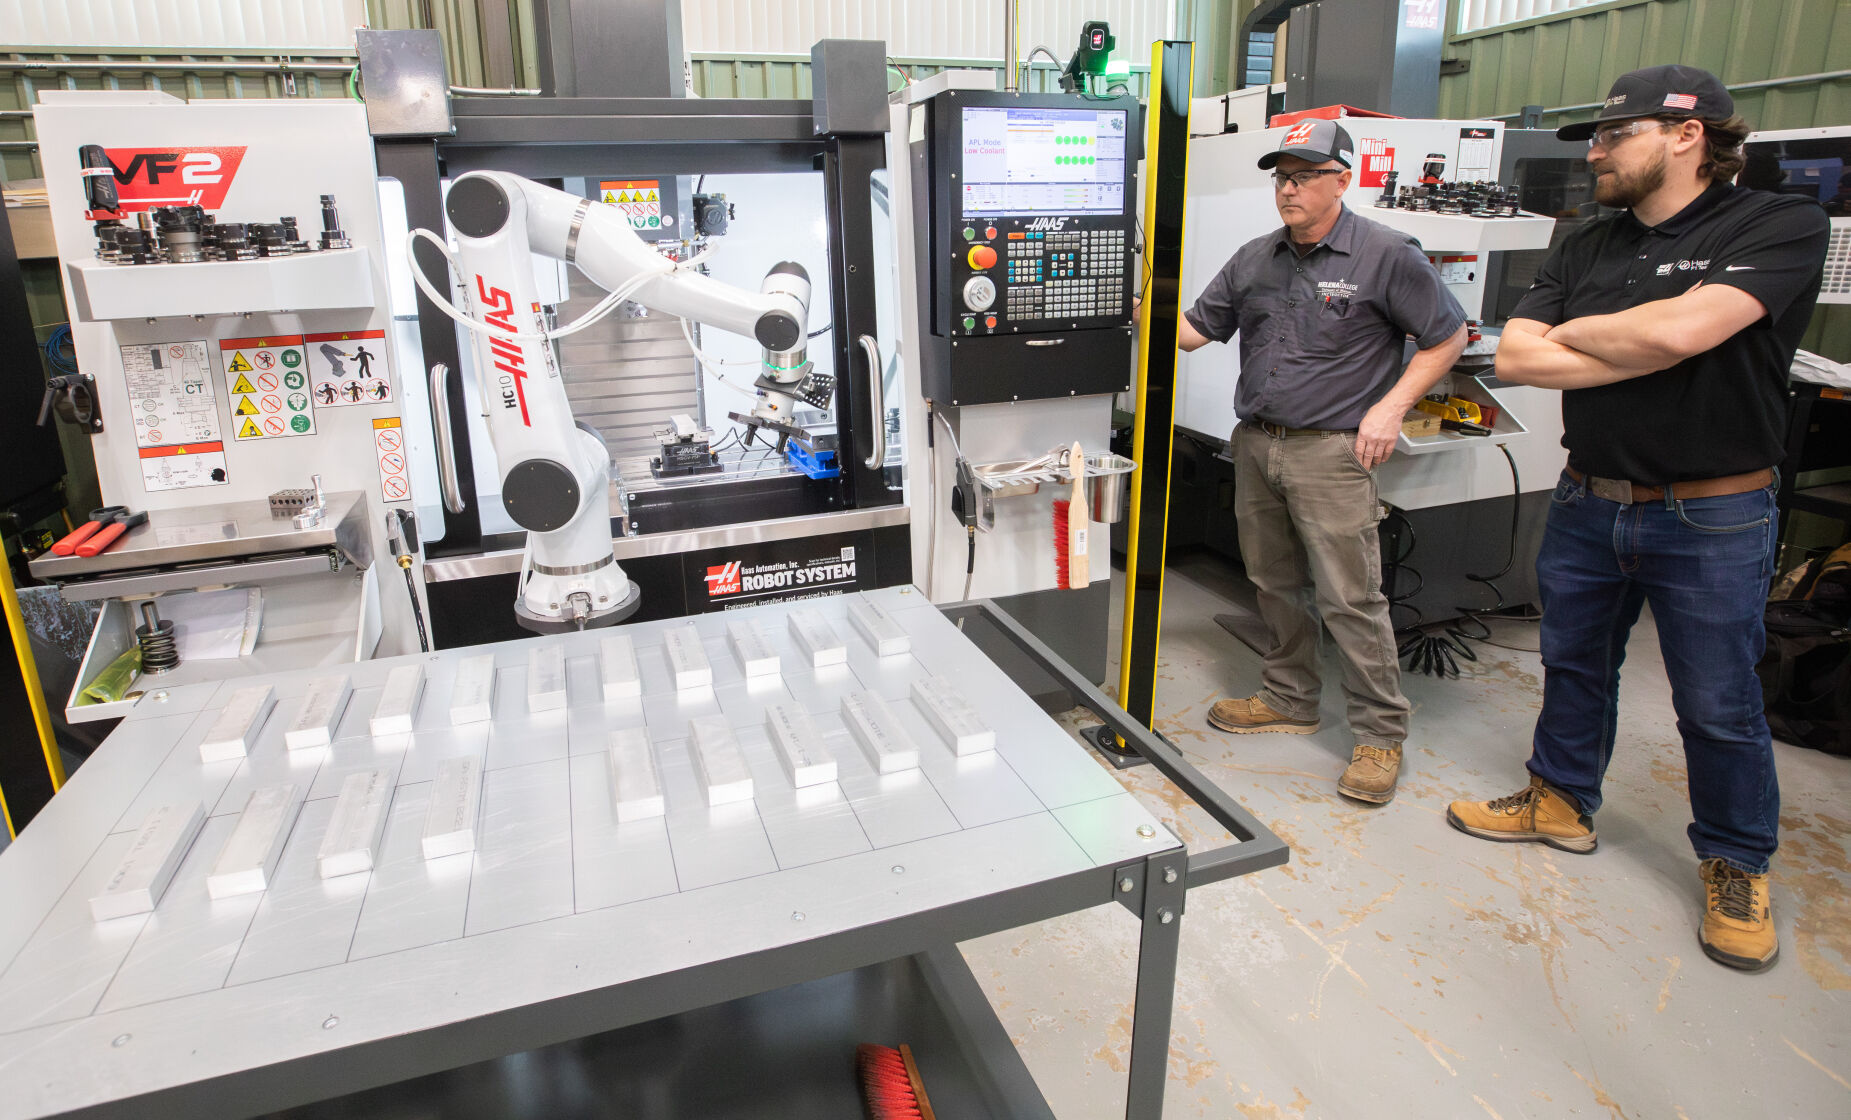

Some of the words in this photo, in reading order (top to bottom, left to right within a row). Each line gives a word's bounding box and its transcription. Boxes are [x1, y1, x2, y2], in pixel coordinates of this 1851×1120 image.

[968, 138, 982, 146] APL
[983, 138, 1001, 146] Mode
[1360, 138, 1387, 156] Mini
[964, 147, 978, 155] Low
[979, 147, 1005, 155] Coolant
[1369, 156, 1393, 172] Mill
[1025, 217, 1069, 231] HAAS
[185, 383, 203, 394] CT
[499, 375, 517, 409] HC10
[741, 567, 754, 575] Haas
[789, 561, 800, 569] Inc.
[742, 570, 794, 592] ROBOT
[795, 562, 856, 584] SYSTEM
[709, 583, 740, 594] HAAS
[797, 591, 820, 601] serviced
[820, 590, 829, 598] by
[829, 588, 843, 596] Haas
